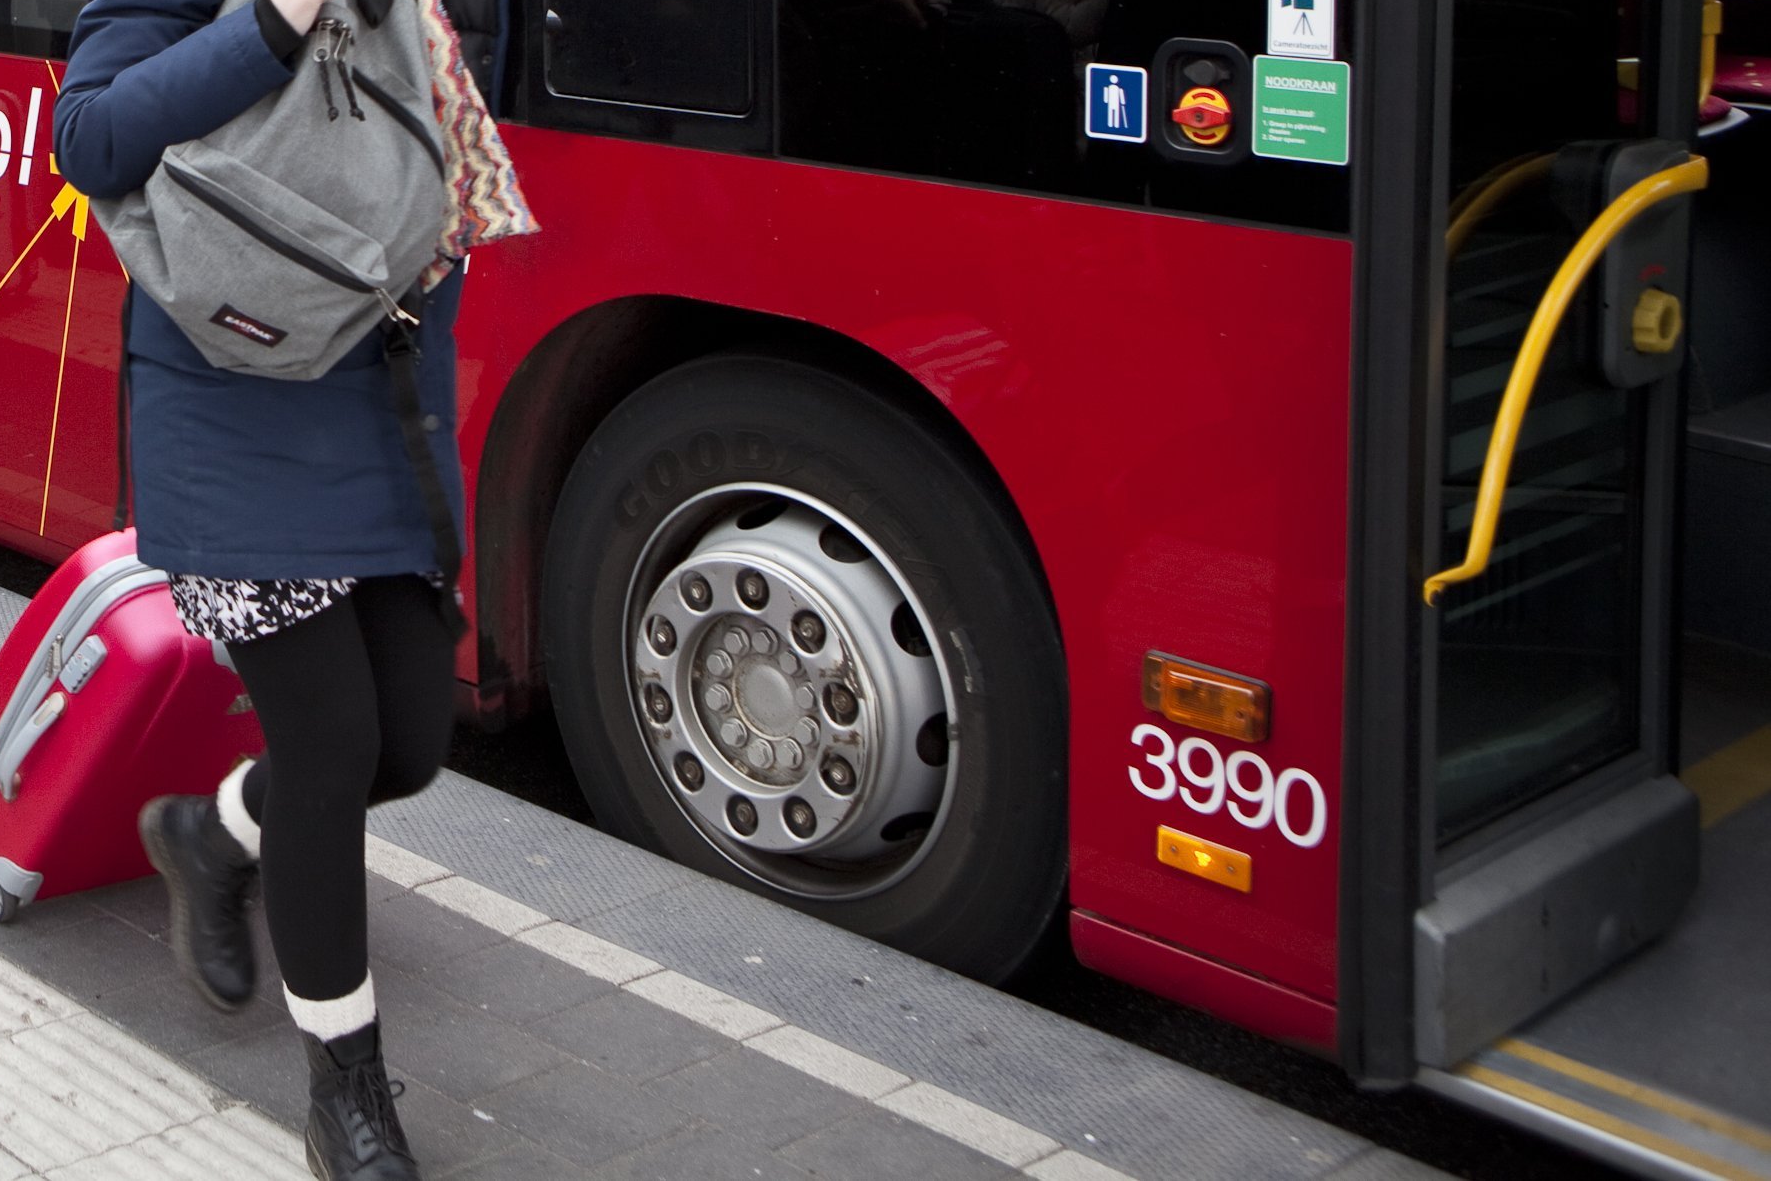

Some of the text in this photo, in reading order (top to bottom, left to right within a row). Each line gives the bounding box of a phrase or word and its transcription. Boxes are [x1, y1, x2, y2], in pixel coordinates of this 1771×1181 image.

[1273, 40, 1328, 51] Cameratoezicht
[1265, 76, 1337, 93] NOODKRAAN
[1128, 724, 1328, 848] 3990
